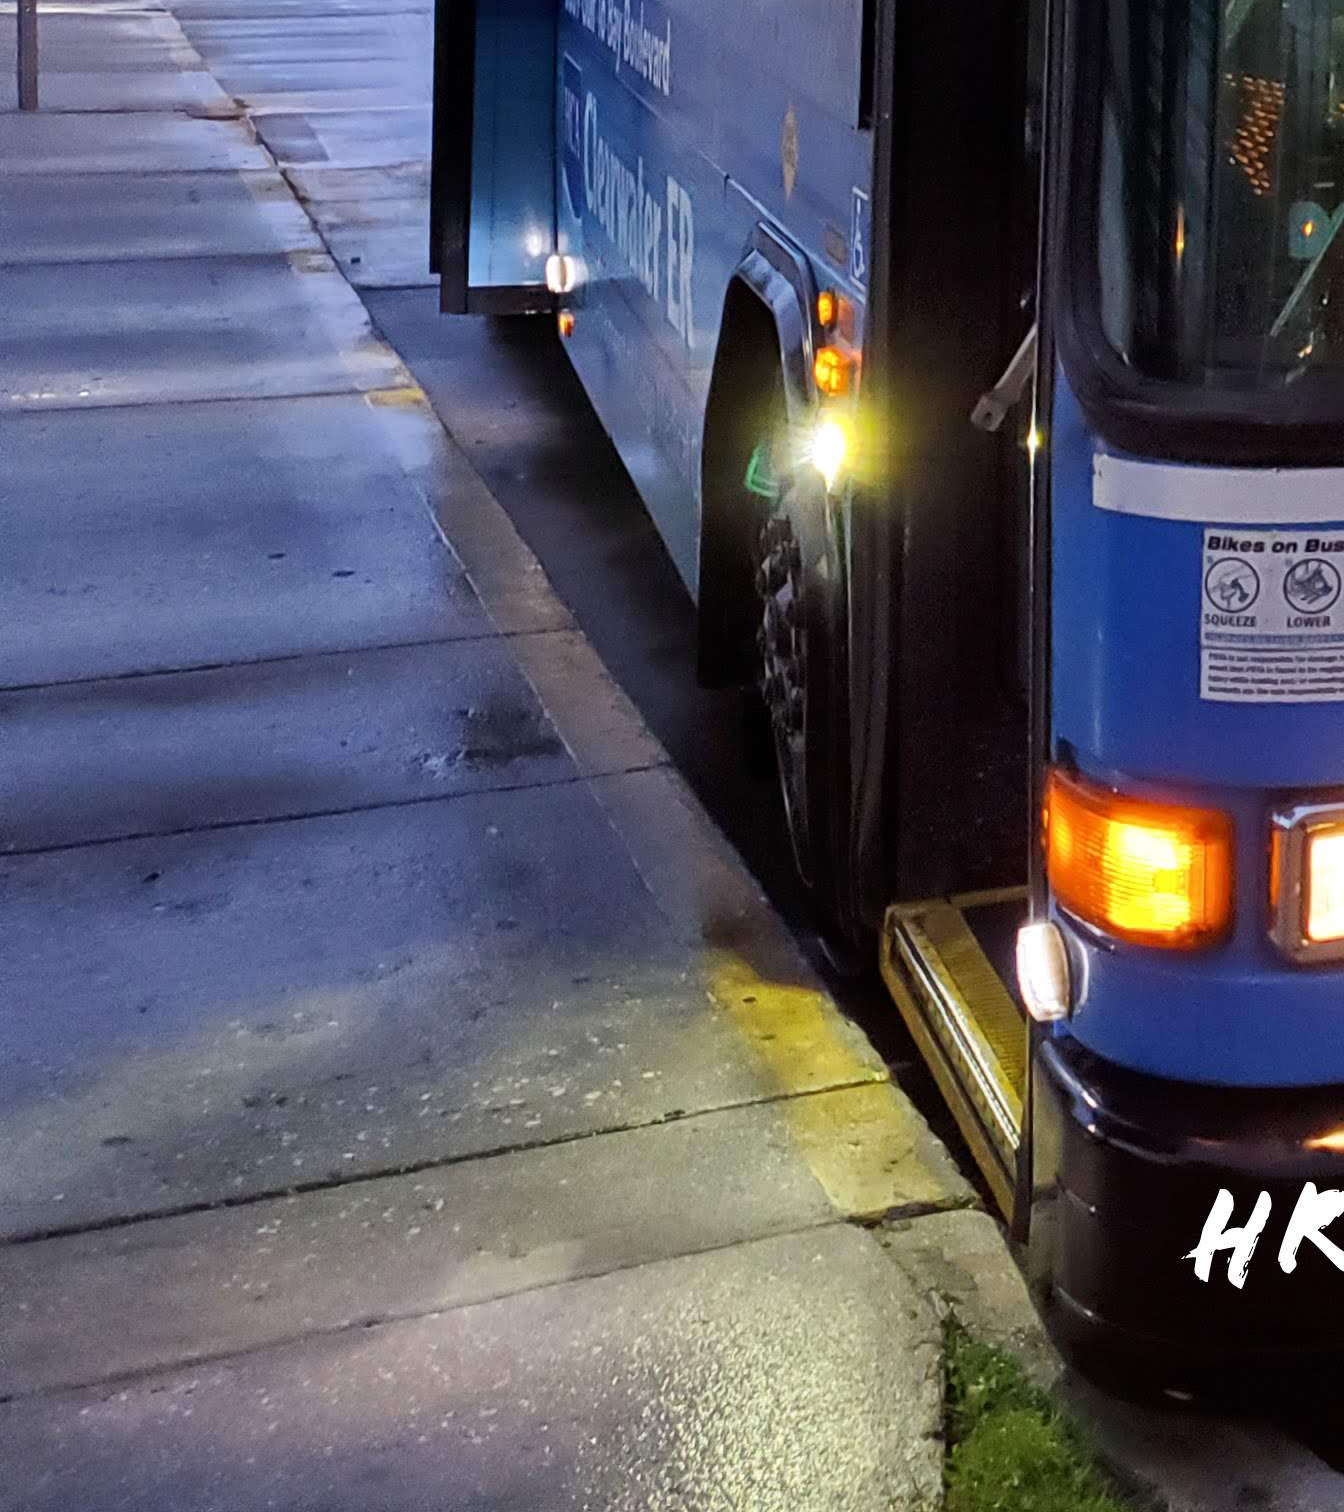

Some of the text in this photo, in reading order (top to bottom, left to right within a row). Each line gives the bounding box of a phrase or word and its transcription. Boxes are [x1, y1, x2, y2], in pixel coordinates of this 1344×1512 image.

[584, 91, 697, 352] Clearwater ER
[1207, 535, 1266, 553] Bikes
[1271, 540, 1299, 554] on
[1203, 612, 1257, 628] SQUEEZE
[1286, 614, 1332, 629] LOWER
